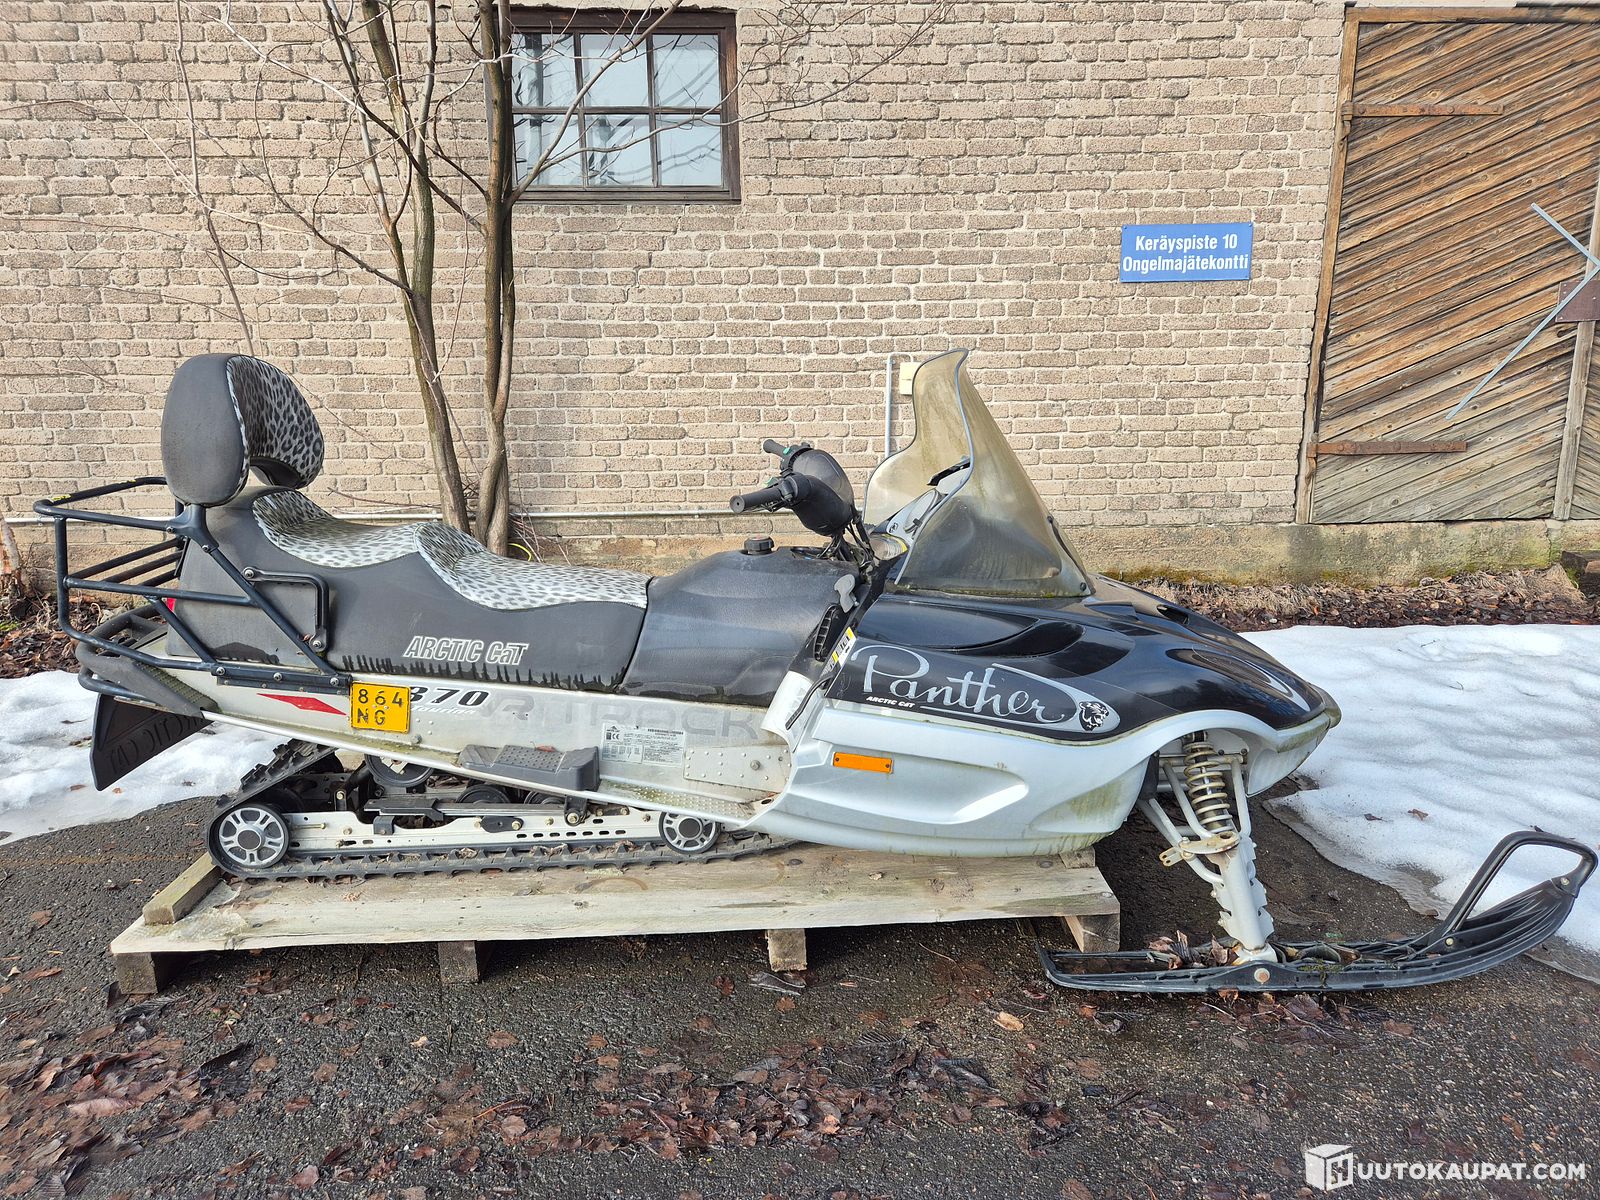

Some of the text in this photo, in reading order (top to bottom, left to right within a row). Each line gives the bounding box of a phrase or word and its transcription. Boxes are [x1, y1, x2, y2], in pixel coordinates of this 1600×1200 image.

[1135, 233, 1238, 254] Keräyspiste 10
[1122, 254, 1249, 274] Ongelmajätekontti
[403, 635, 484, 663] ARCTIC
[851, 645, 1065, 723] Panther
[358, 688, 403, 708] 864
[866, 696, 898, 705] ARCTIC
[357, 708, 386, 725] NG
